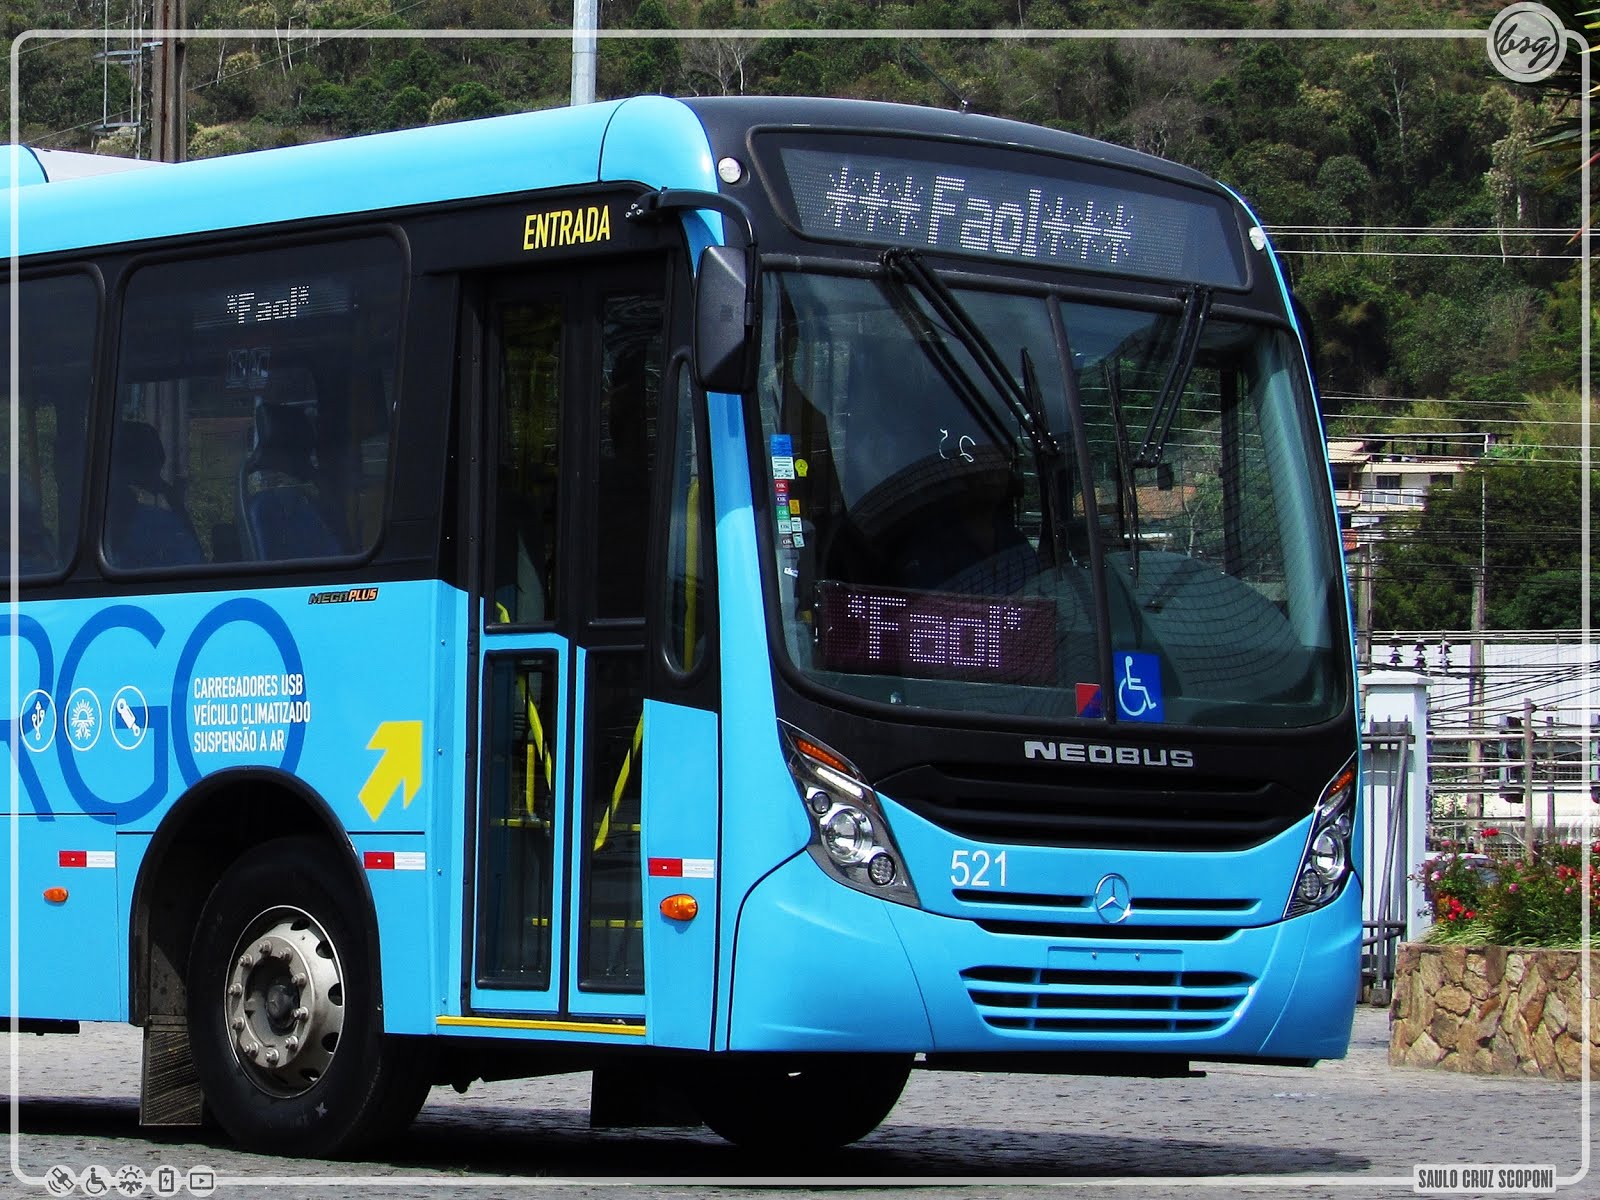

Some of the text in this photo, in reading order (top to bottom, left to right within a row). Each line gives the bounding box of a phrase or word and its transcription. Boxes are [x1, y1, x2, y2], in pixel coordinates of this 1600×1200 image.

[523, 204, 611, 251] ENTRADA
[193, 673, 304, 699] CARREGADORES USB
[193, 699, 311, 726] VEÍCULO CLIMATIZADO
[193, 726, 285, 753] SUSPENSÃO A AR
[1023, 740, 1195, 768] NEOBUS
[950, 850, 1008, 888] 521
